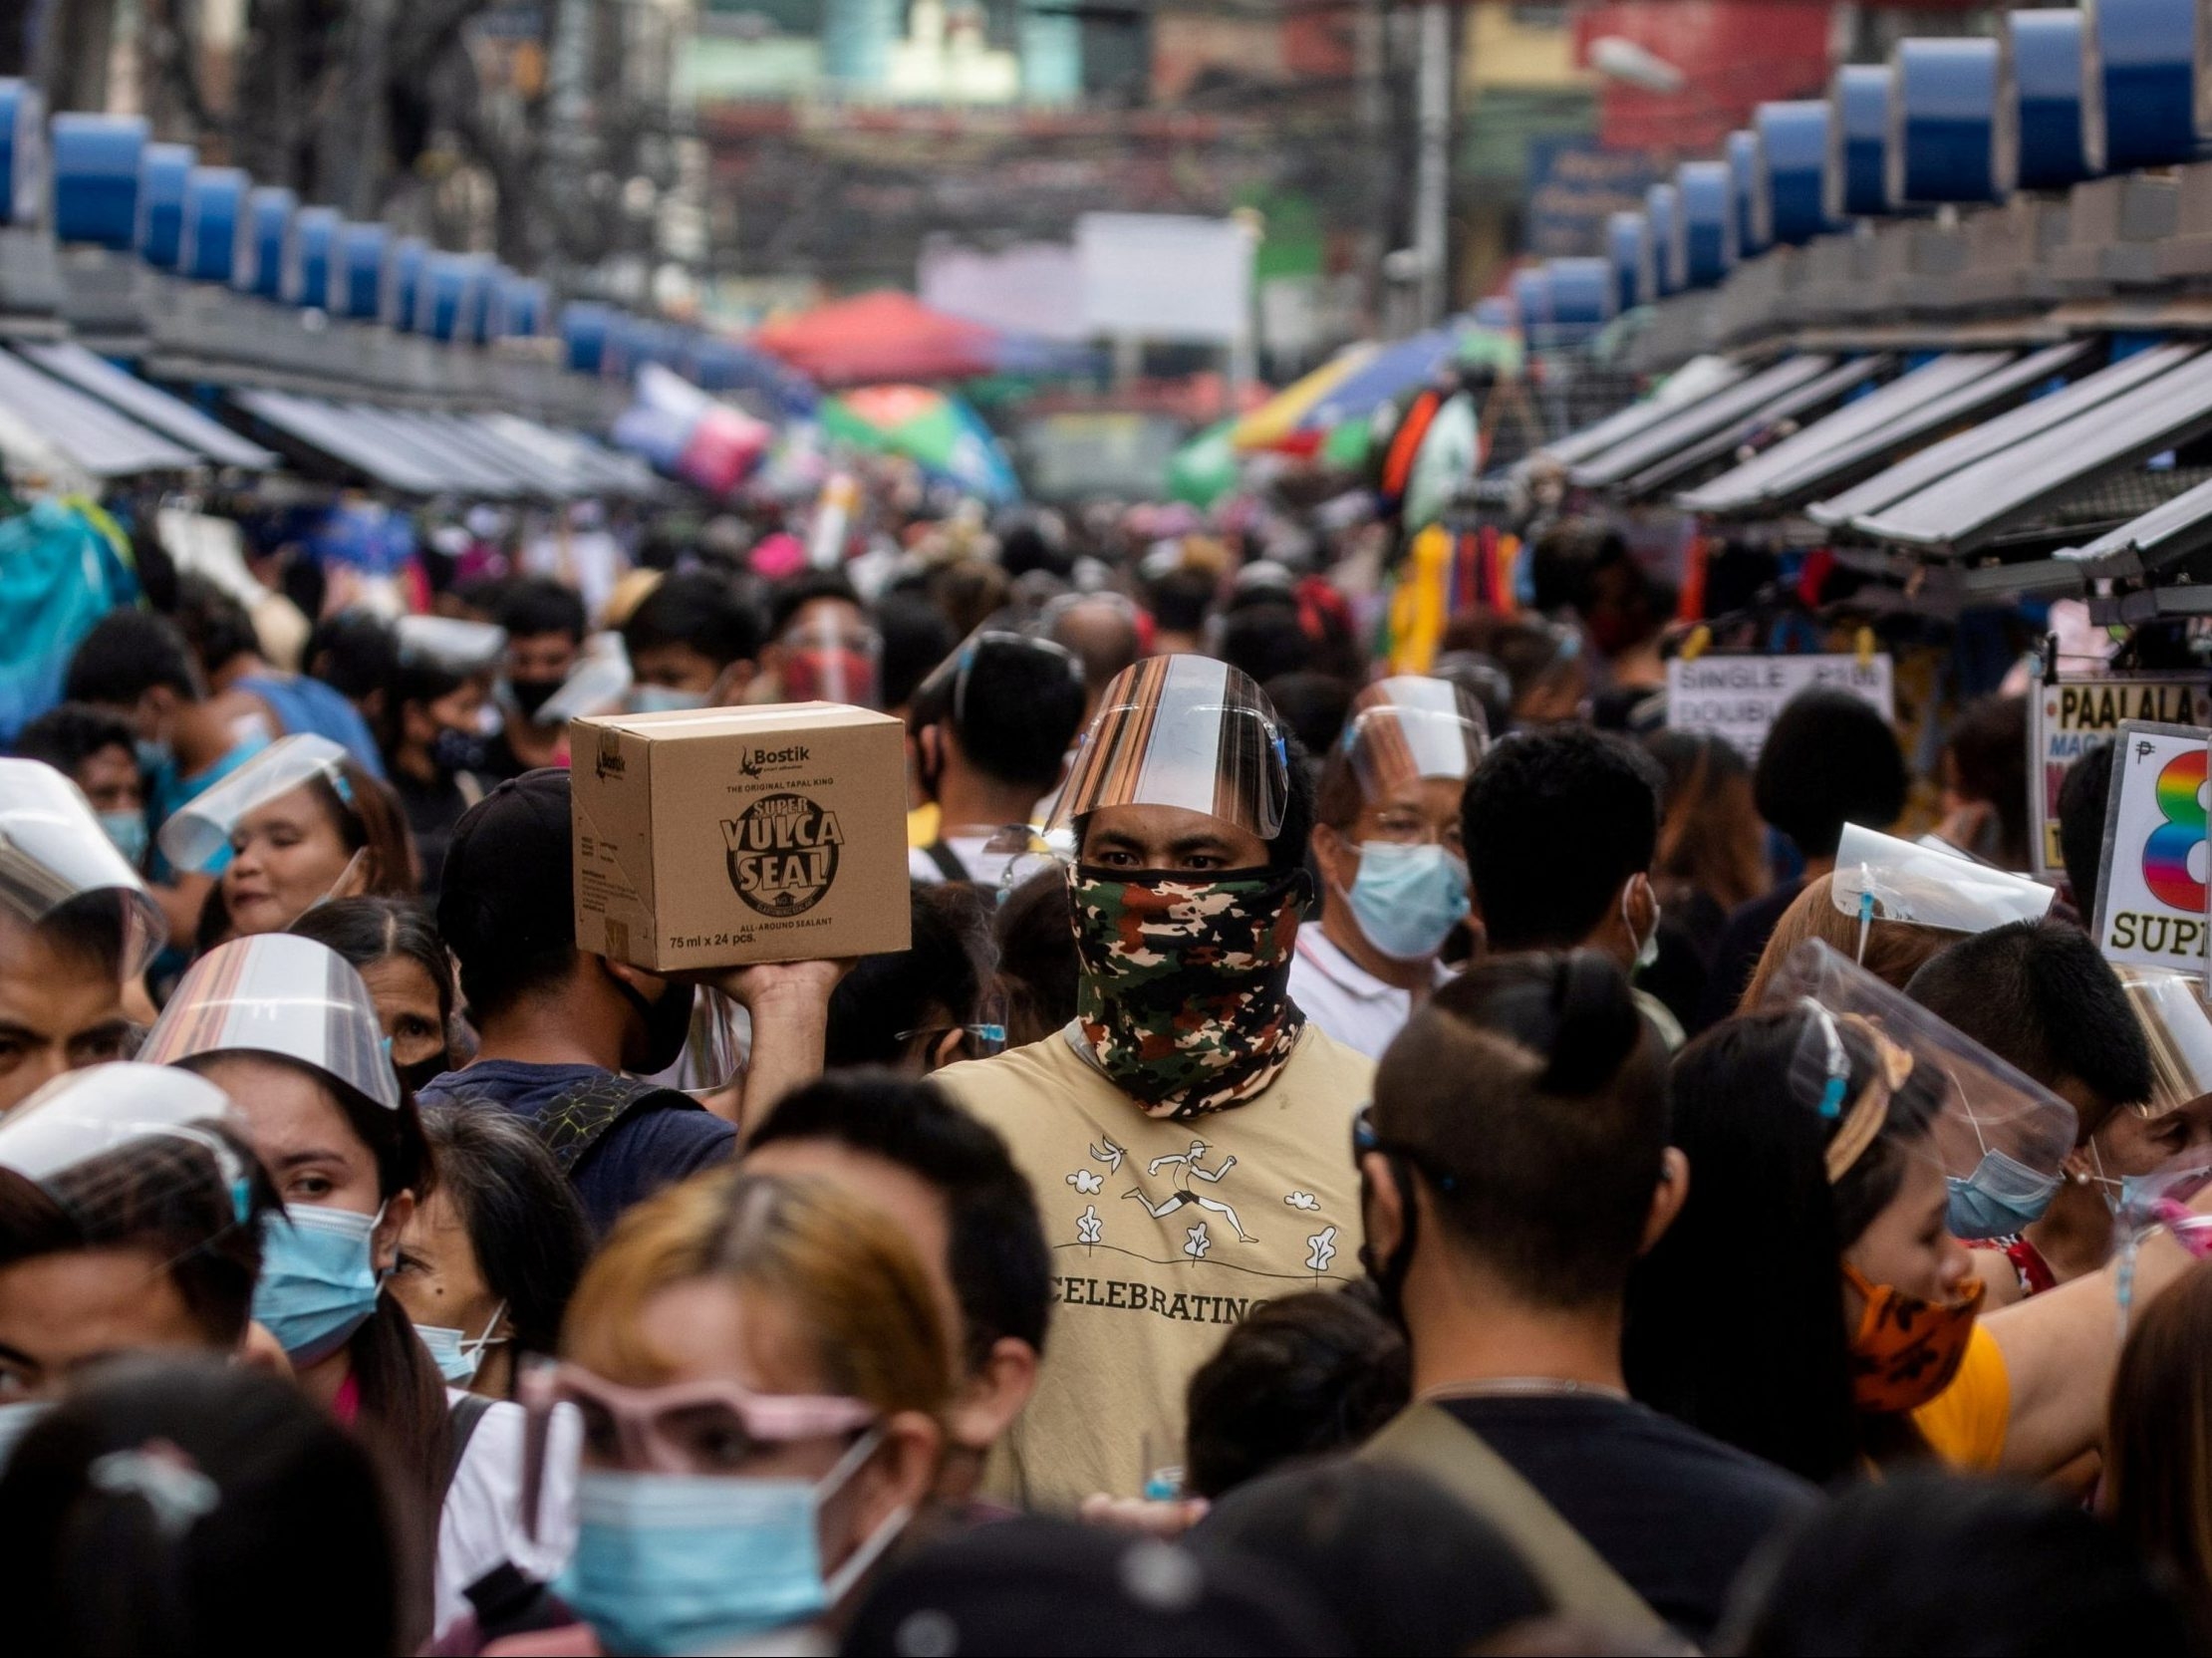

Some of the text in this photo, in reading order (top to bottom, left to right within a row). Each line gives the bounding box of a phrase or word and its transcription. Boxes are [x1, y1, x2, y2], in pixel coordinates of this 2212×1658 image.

[2062, 687, 2193, 728] PAALALA
[754, 745, 810, 764] Bostik
[744, 782, 785, 793] ORIGINAL
[786, 778, 812, 788] TAPAL
[813, 777, 834, 786] KING
[752, 797, 809, 816] SUPER
[718, 810, 845, 852] VULCA
[738, 852, 828, 893] SEAL
[739, 917, 832, 933] ALL-AROUND SEALANT
[670, 933, 756, 949] 75 ml x 24 pcs.
